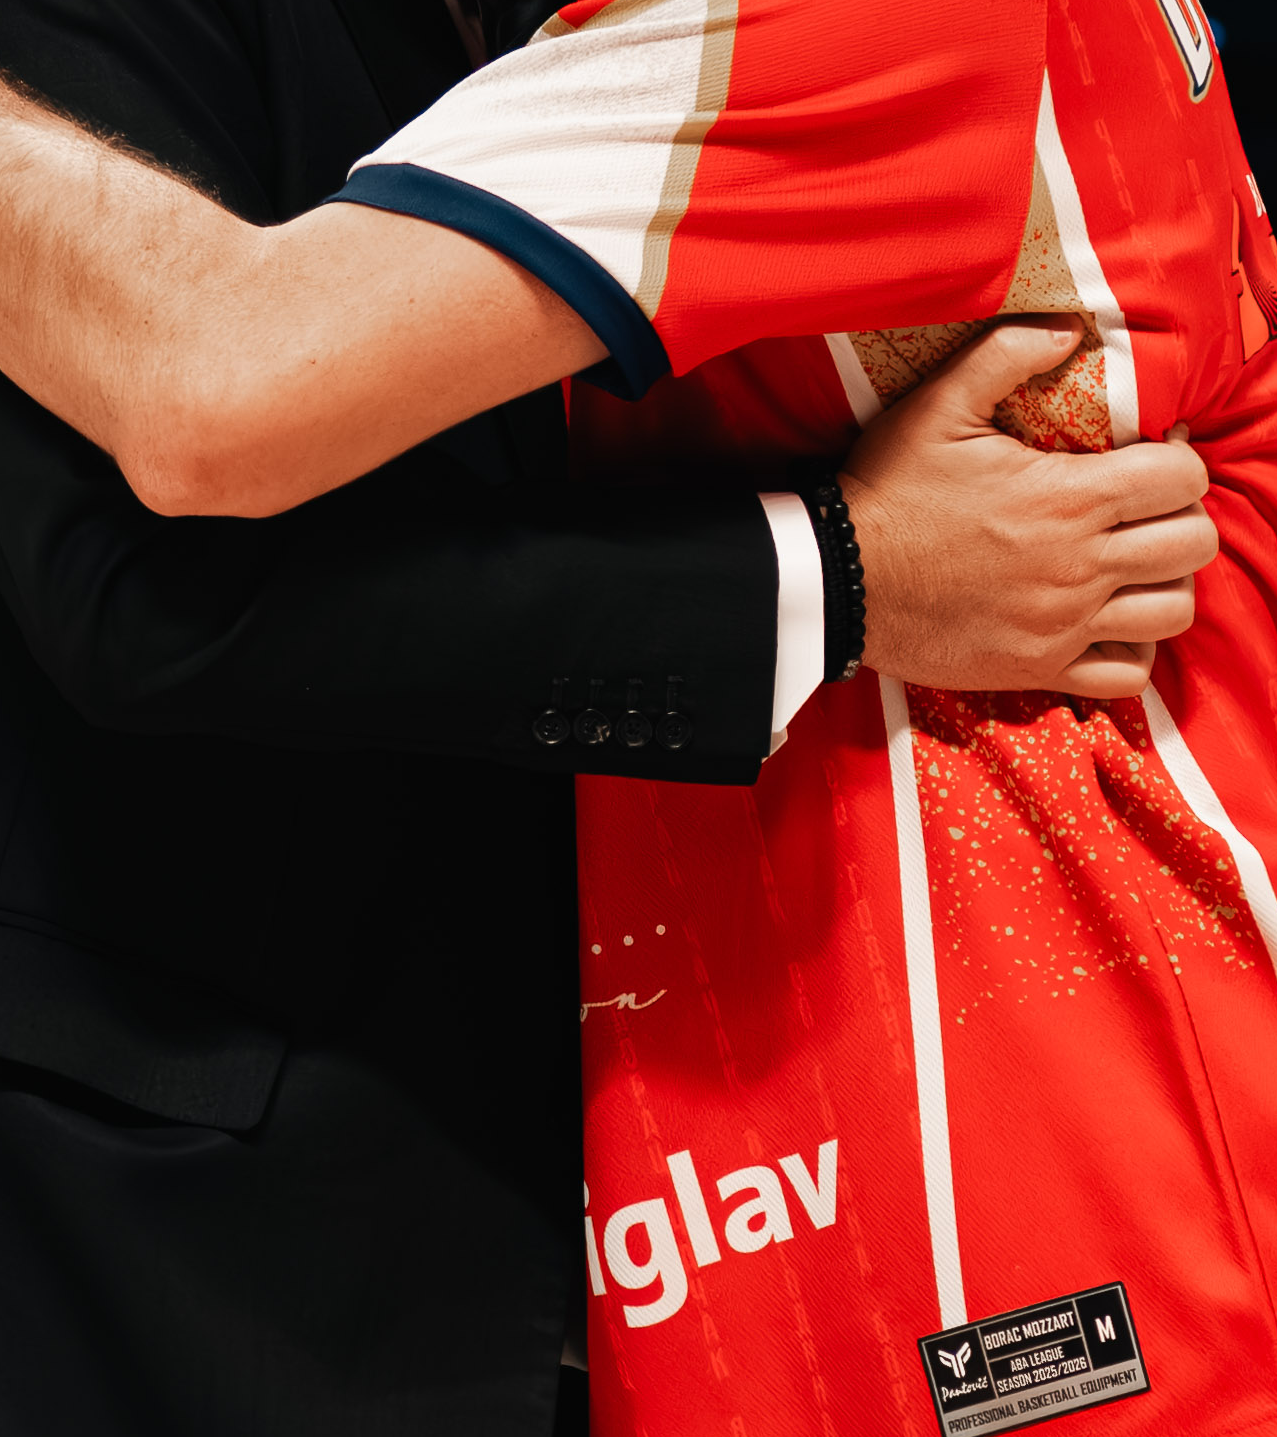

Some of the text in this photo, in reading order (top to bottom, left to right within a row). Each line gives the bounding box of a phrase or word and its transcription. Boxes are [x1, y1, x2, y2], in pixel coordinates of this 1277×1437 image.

[983, 1311, 1075, 1351] BORAC MOZZART
[1095, 1315, 1117, 1343] M
[996, 1357, 1088, 1394] SEASON 2025/2026
[1010, 1346, 1065, 1373] ABA LEAGUE
[948, 1368, 1138, 1434] PROFESSIONAL BASKETBALL EQUIPMENT
